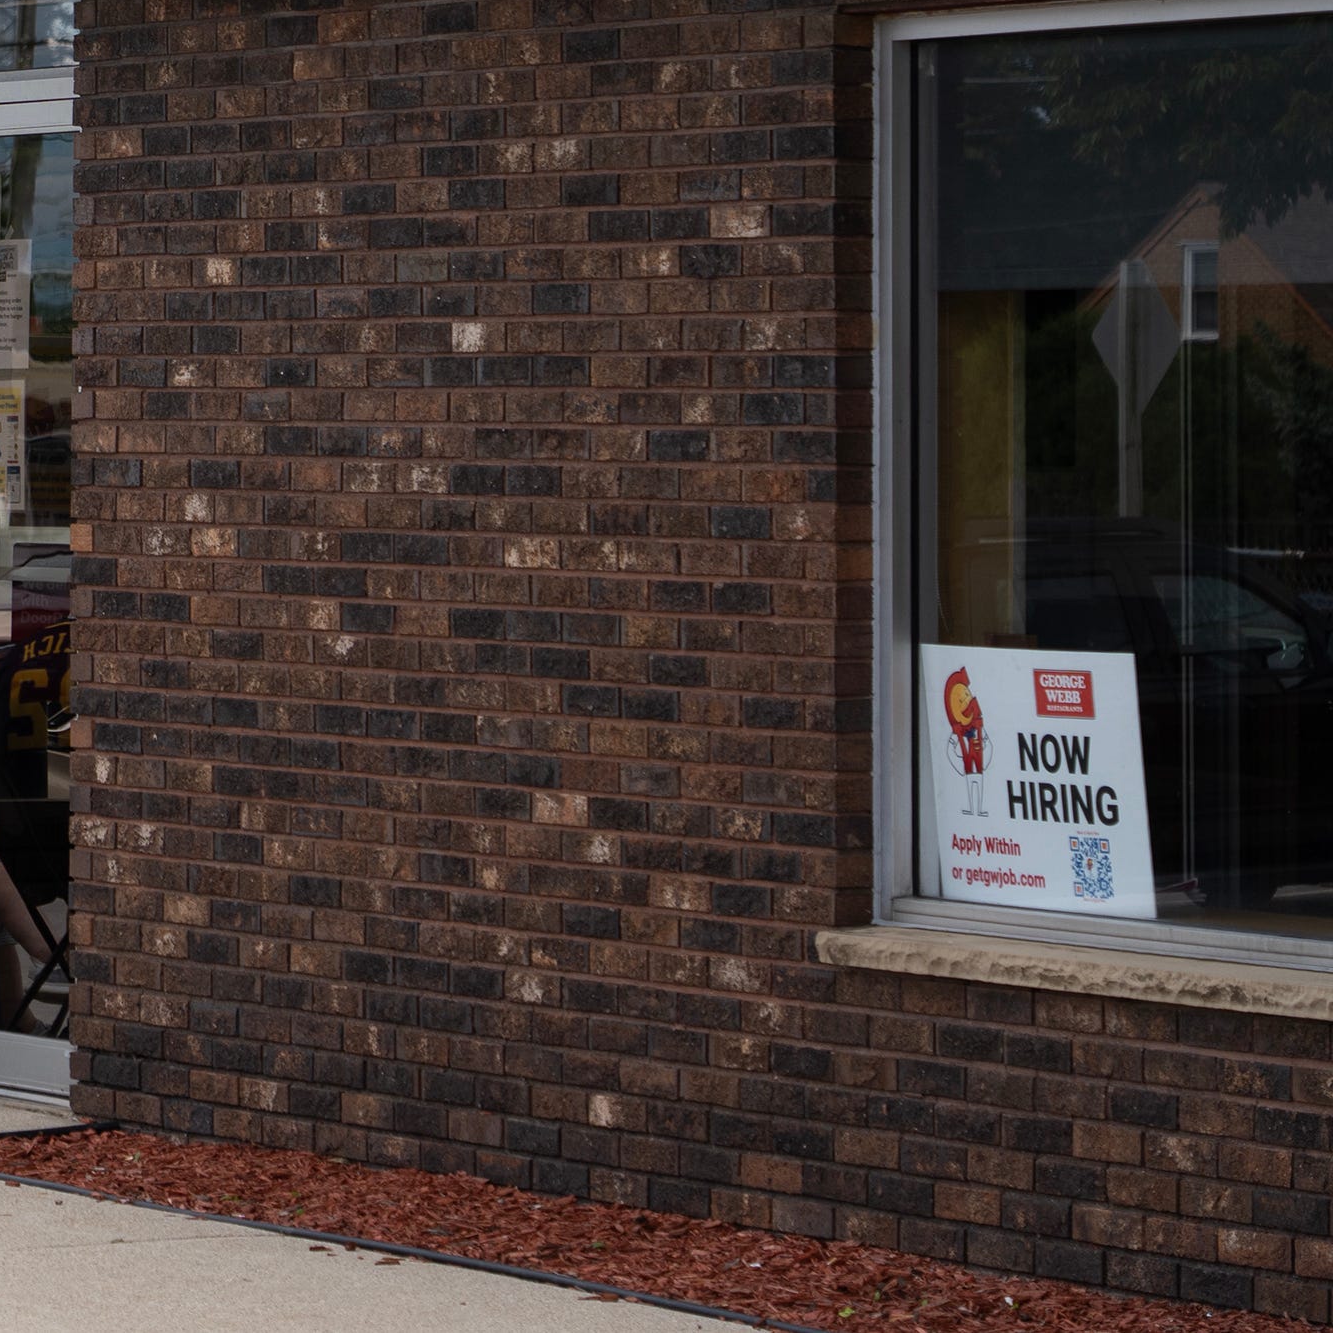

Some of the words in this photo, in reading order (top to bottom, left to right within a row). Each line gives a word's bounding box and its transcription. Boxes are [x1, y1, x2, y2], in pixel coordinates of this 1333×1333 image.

[1040, 674, 1086, 689] GEORGE
[1045, 690, 1082, 704] WEBB
[1018, 733, 1090, 775] NOW
[1007, 781, 1119, 826] HIRING
[952, 834, 982, 856] Apply
[984, 836, 1021, 856] Within
[952, 867, 963, 879] or
[966, 867, 1045, 888] getgwjob.com
